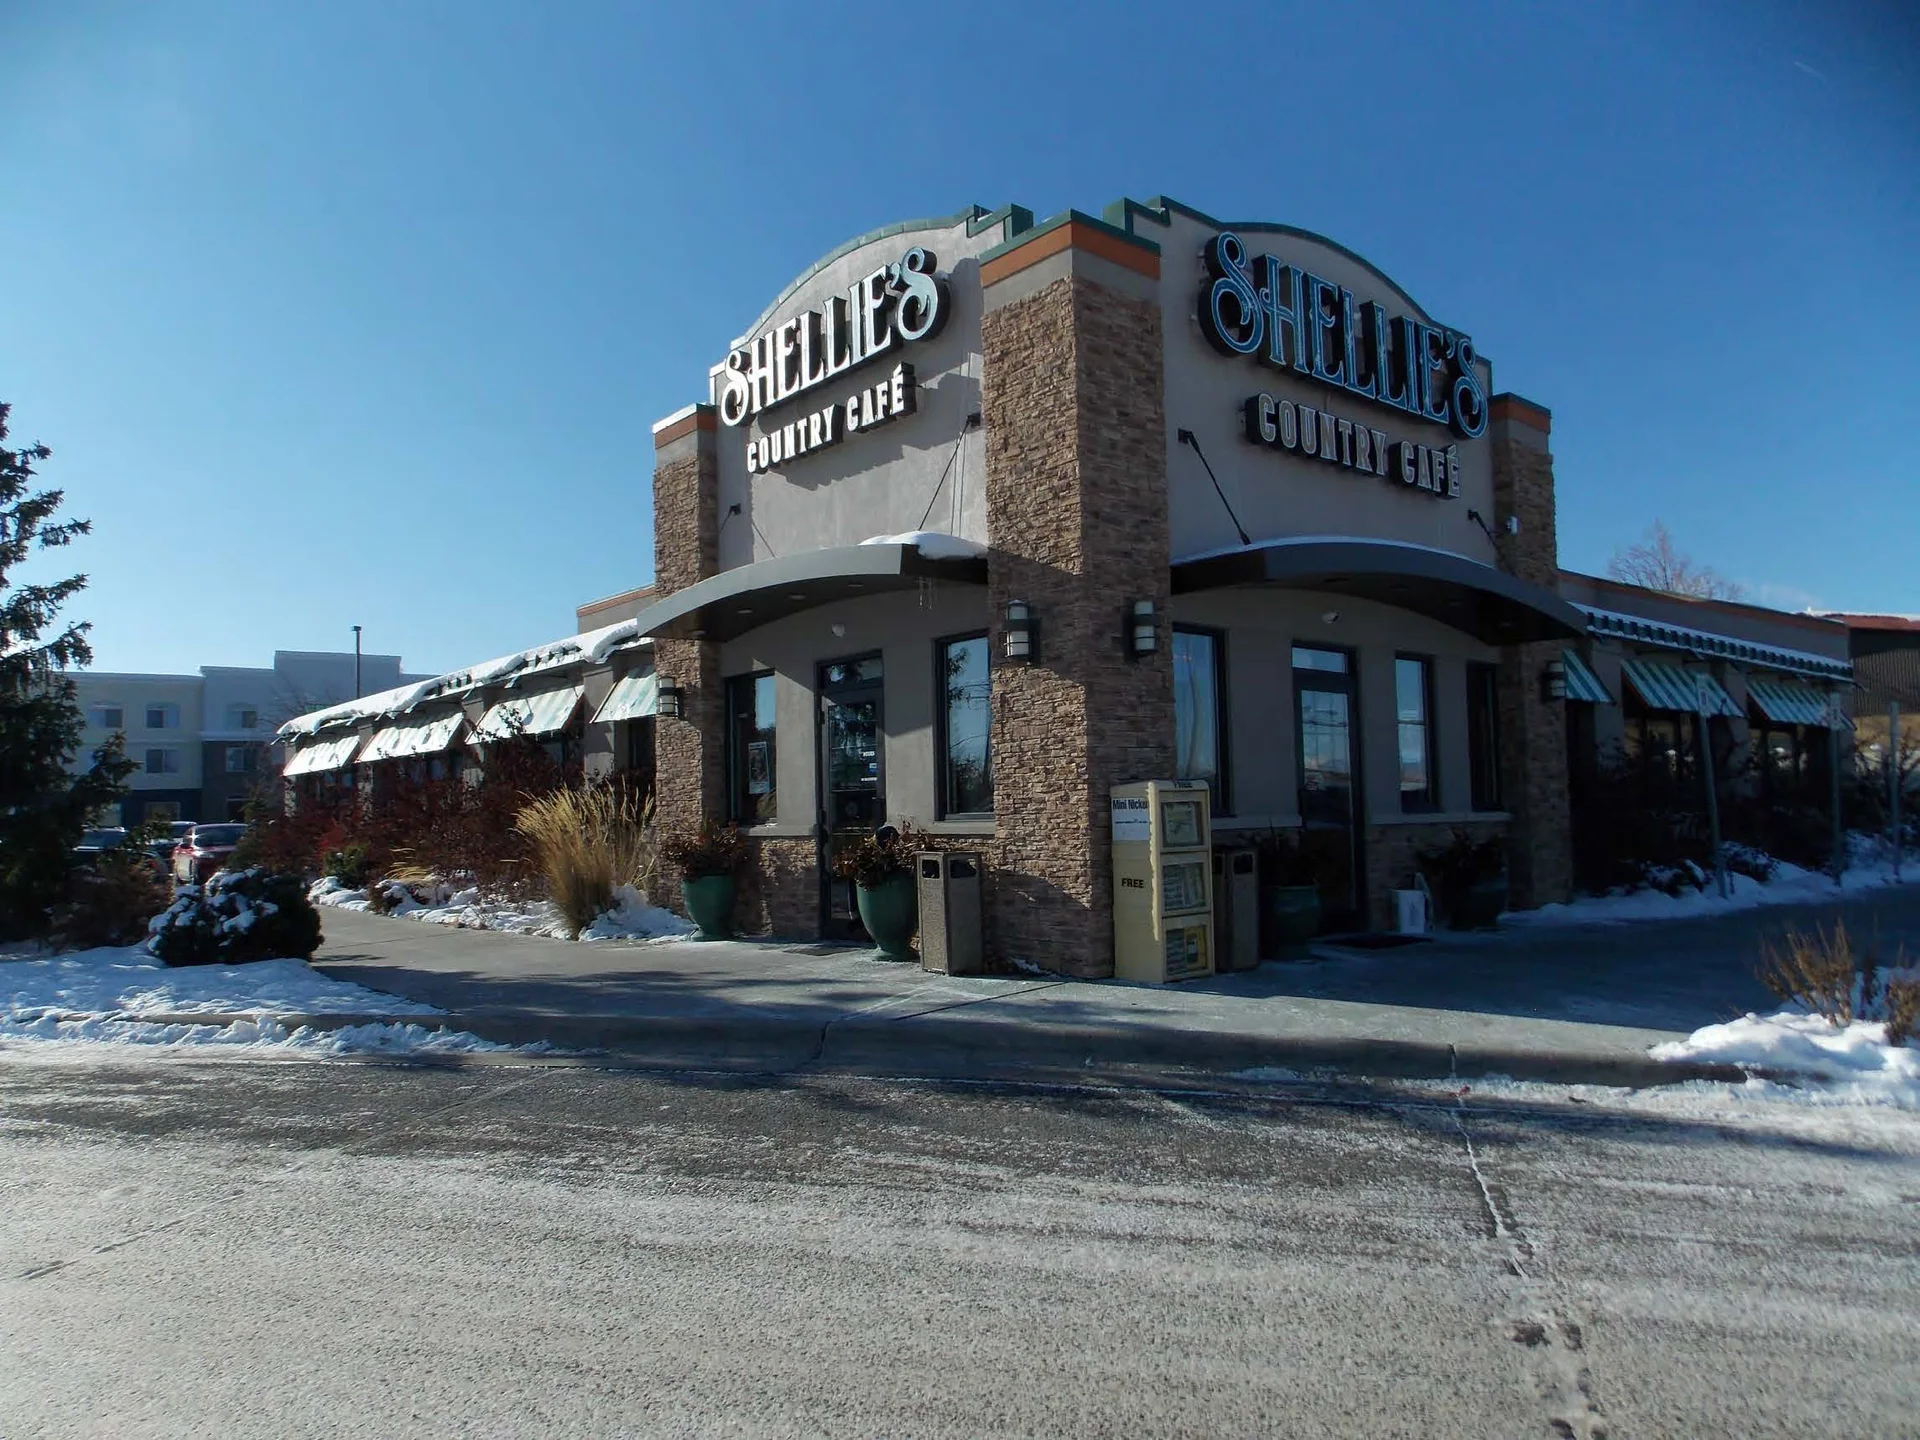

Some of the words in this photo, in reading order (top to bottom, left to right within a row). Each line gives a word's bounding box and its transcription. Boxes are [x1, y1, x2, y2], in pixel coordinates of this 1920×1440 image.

[720, 246, 939, 427] SHELLIE'S
[1211, 231, 1489, 438] SHELLIE'S
[746, 403, 837, 473] COUNTRY
[846, 362, 905, 432] CAFÉ
[1258, 393, 1388, 477] COUNTRY
[1401, 440, 1461, 498] CAFÉ
[1112, 799, 1127, 810] Mini
[1121, 877, 1145, 889] FREE
